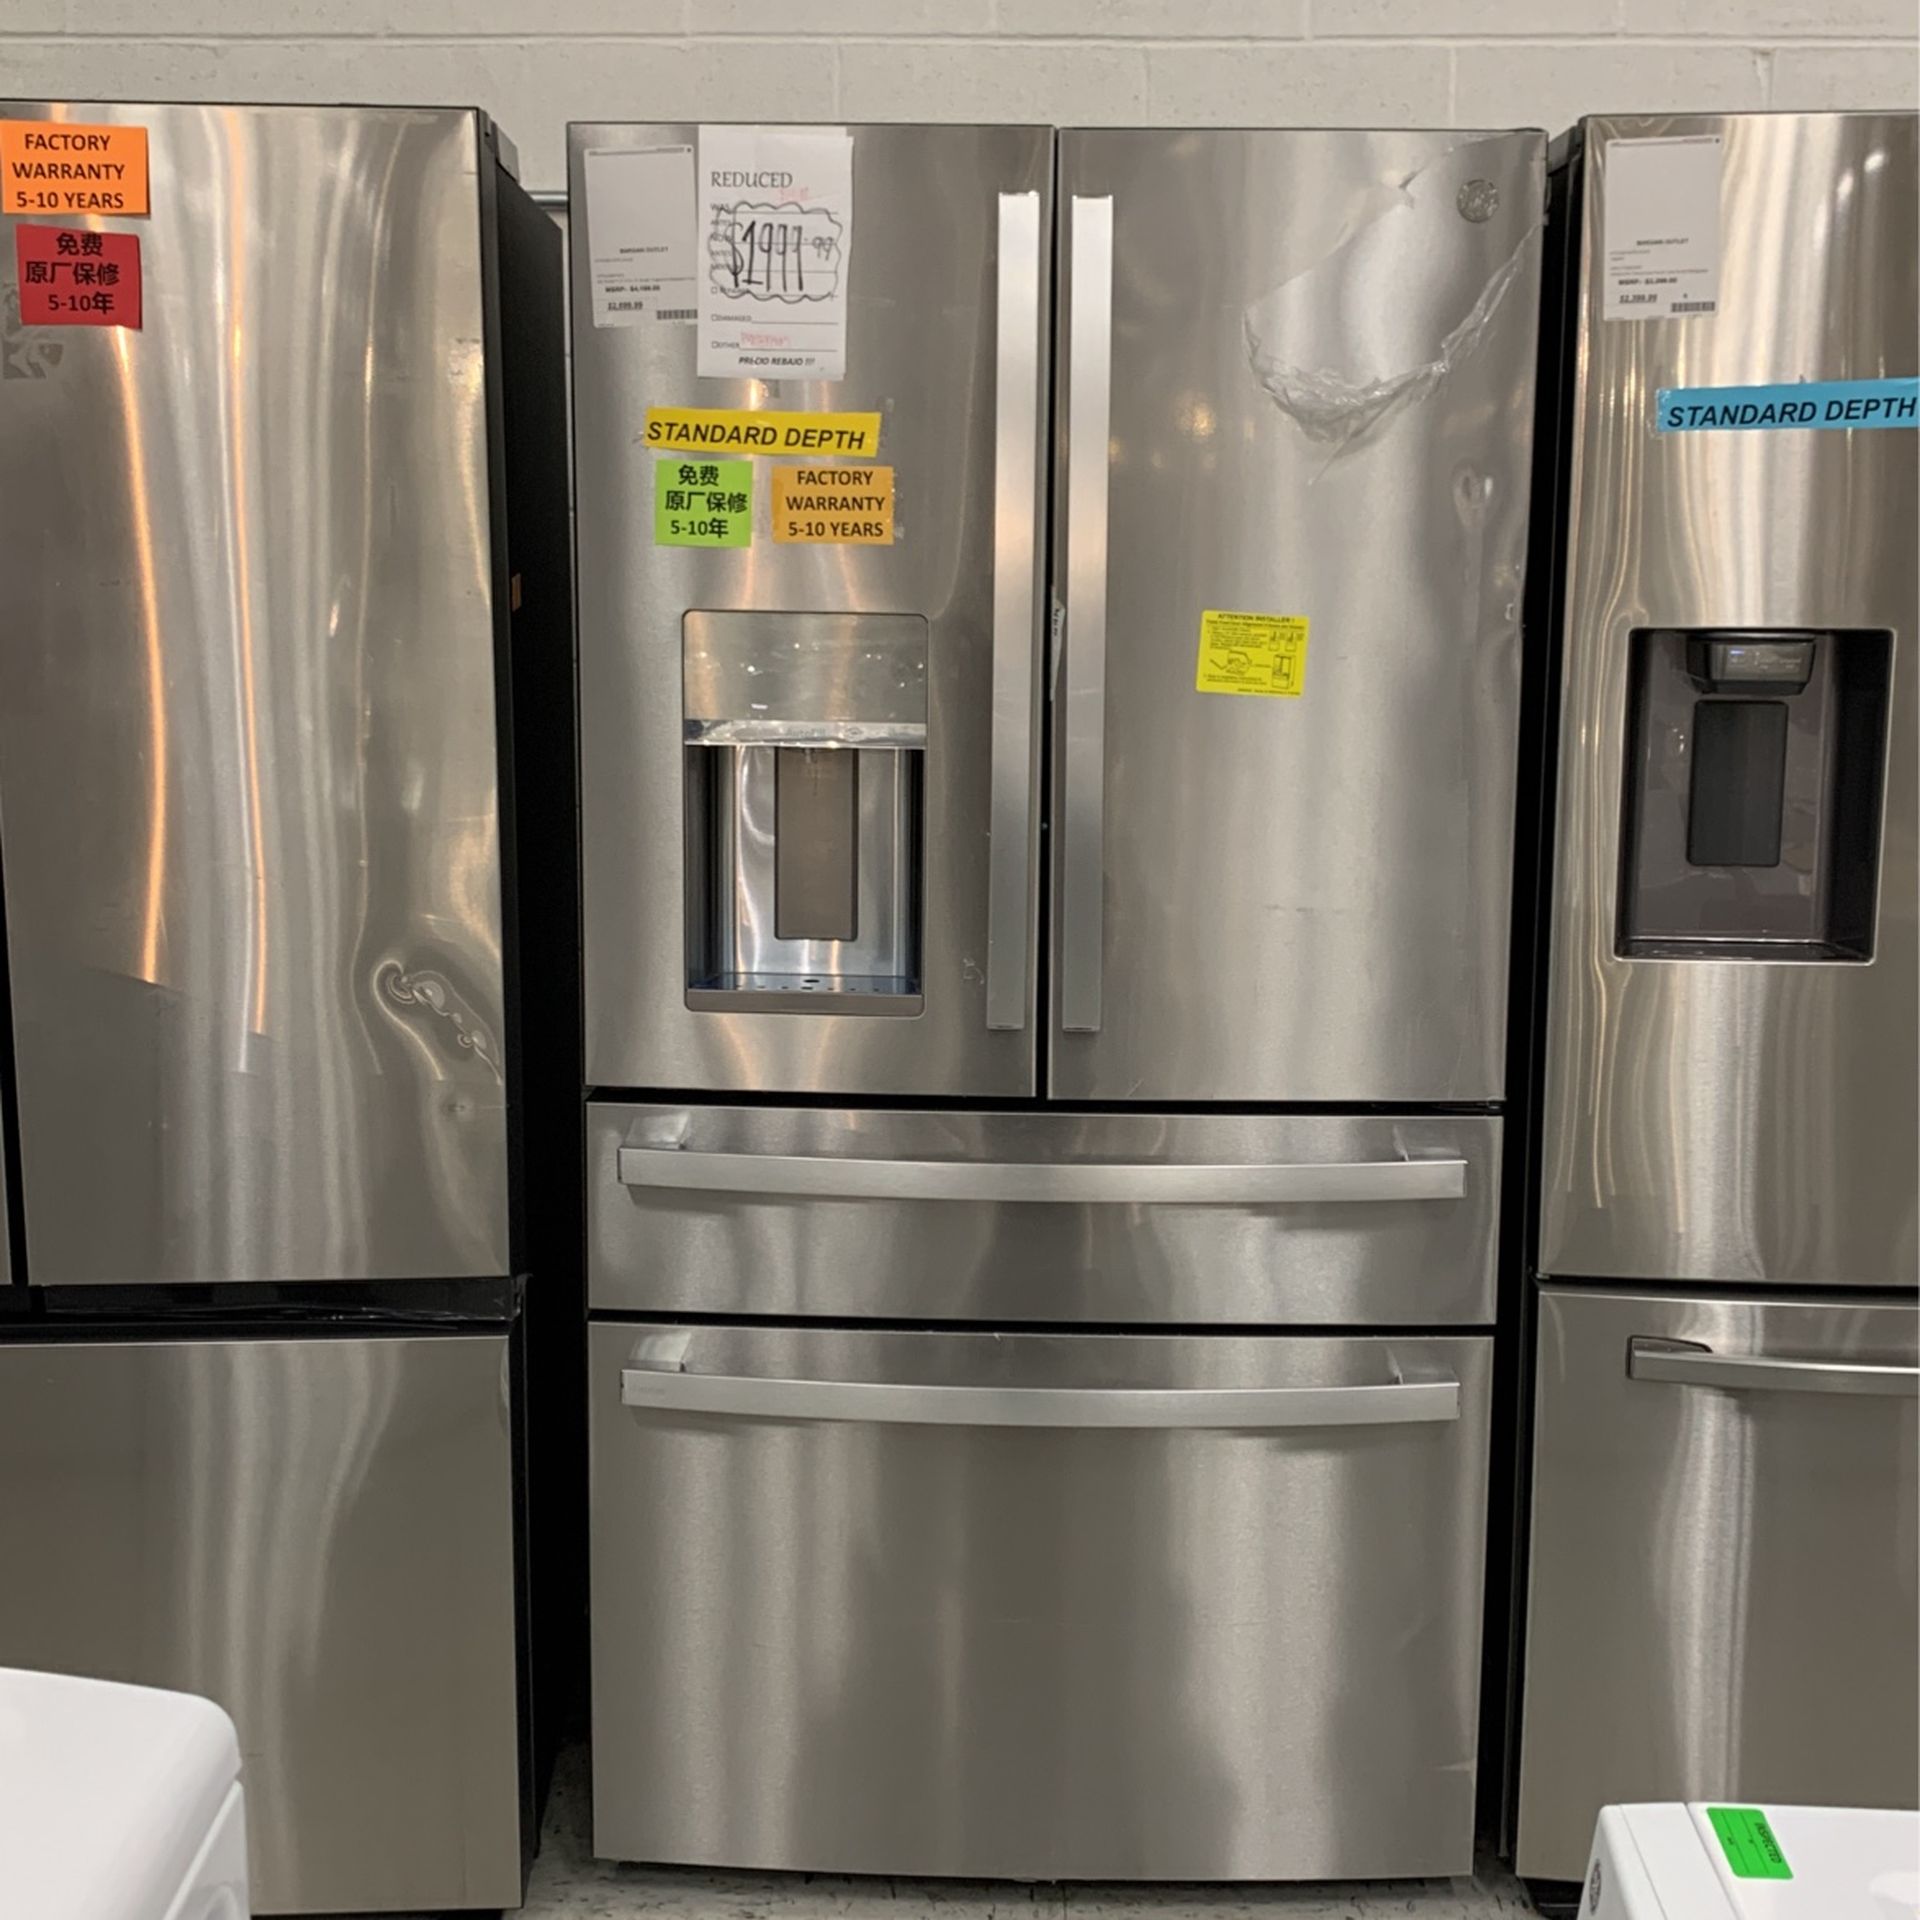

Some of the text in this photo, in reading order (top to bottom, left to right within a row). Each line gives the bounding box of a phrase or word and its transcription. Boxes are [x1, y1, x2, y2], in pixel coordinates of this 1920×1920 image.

[25, 133, 111, 151] FACTORY
[12, 162, 125, 180] WARRANTY
[710, 171, 793, 188] REDUCED
[17, 191, 124, 209] 5-10 YEARS
[56, 232, 103, 256] 免费
[25, 261, 120, 286] 原厂保修
[48, 291, 114, 315] 5-10年
[1667, 396, 1919, 427] STANDARD DEPTH
[648, 421, 866, 450] STANDARD DEPTH
[678, 464, 719, 486] 免费
[797, 470, 873, 486] FACTORY
[665, 490, 748, 514] 原厂保修
[785, 496, 885, 511] WARRANTY
[671, 518, 729, 539] 5-10年
[788, 521, 884, 537] 5-10 YEARS
